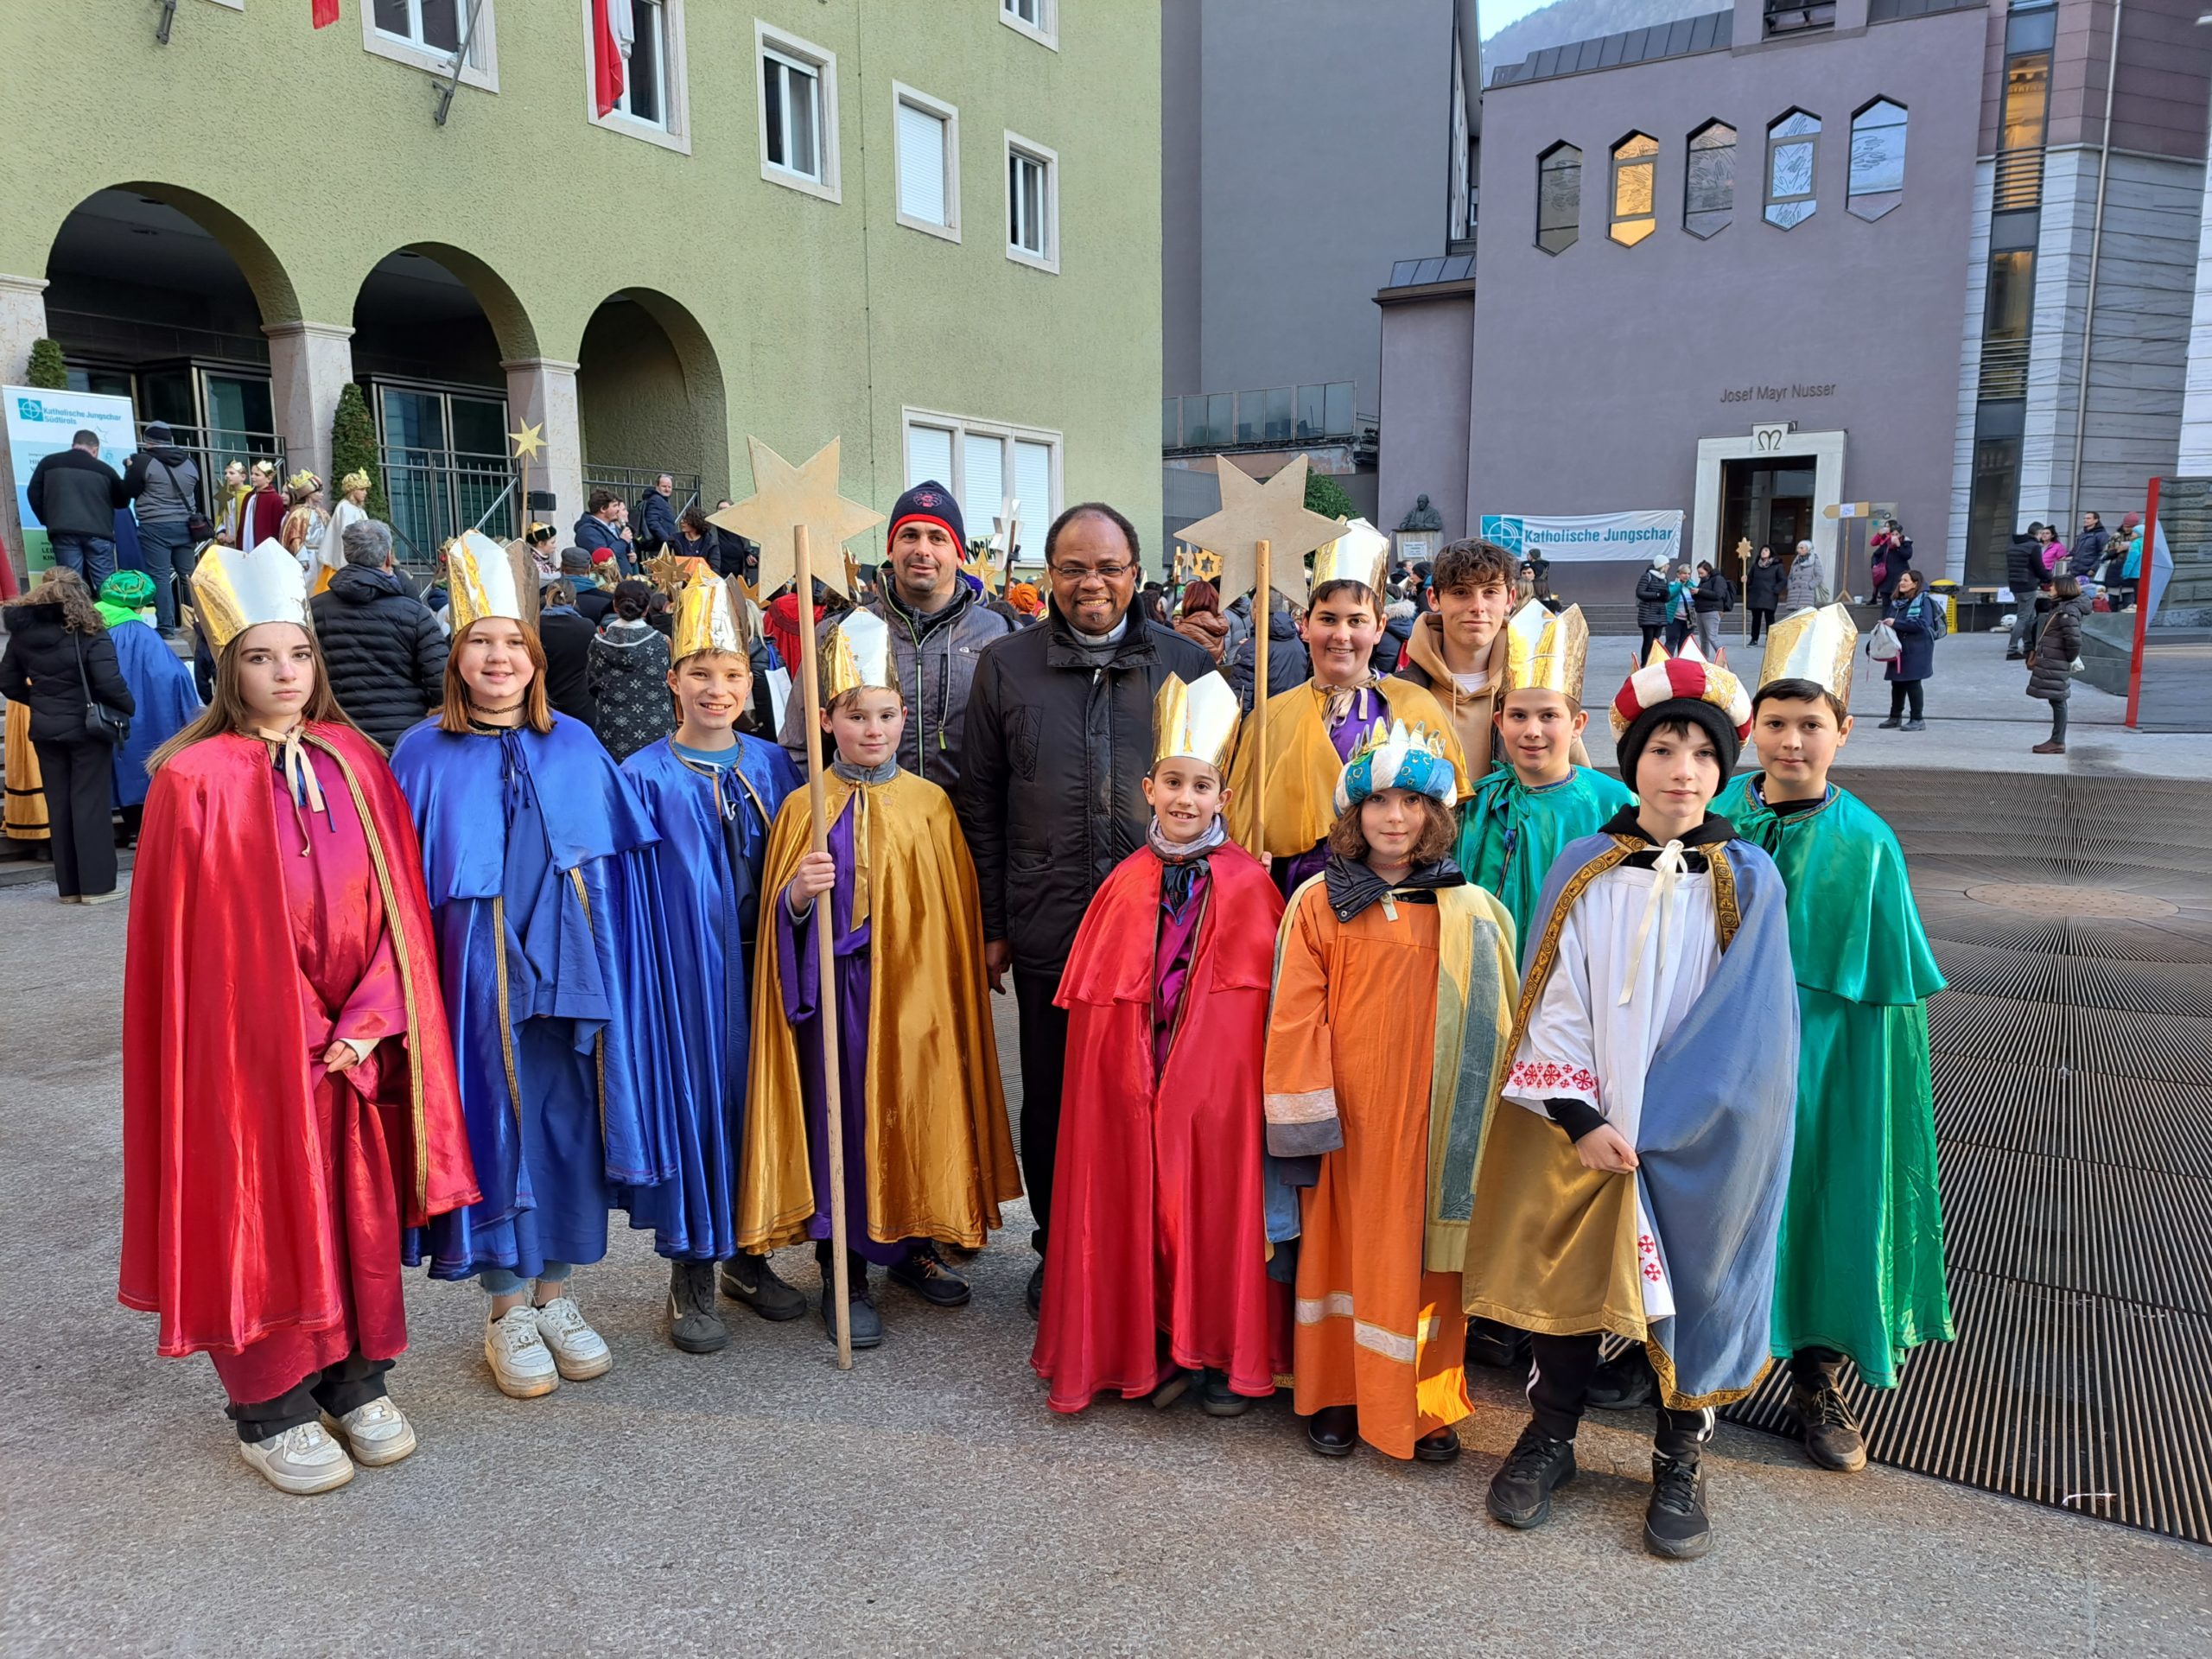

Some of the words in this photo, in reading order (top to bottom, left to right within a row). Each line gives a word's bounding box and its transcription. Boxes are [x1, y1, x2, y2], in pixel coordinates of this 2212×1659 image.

[1719, 386, 1753, 404] Josef
[1757, 385, 1788, 403] Mayr
[1791, 383, 1836, 398] Nusser
[43, 407, 85, 418] Katholische
[86, 410, 121, 421] Jungschar
[44, 416, 77, 425] Südtirols
[1524, 528, 1599, 543] Katholische
[1603, 526, 1673, 544] Jungschar
